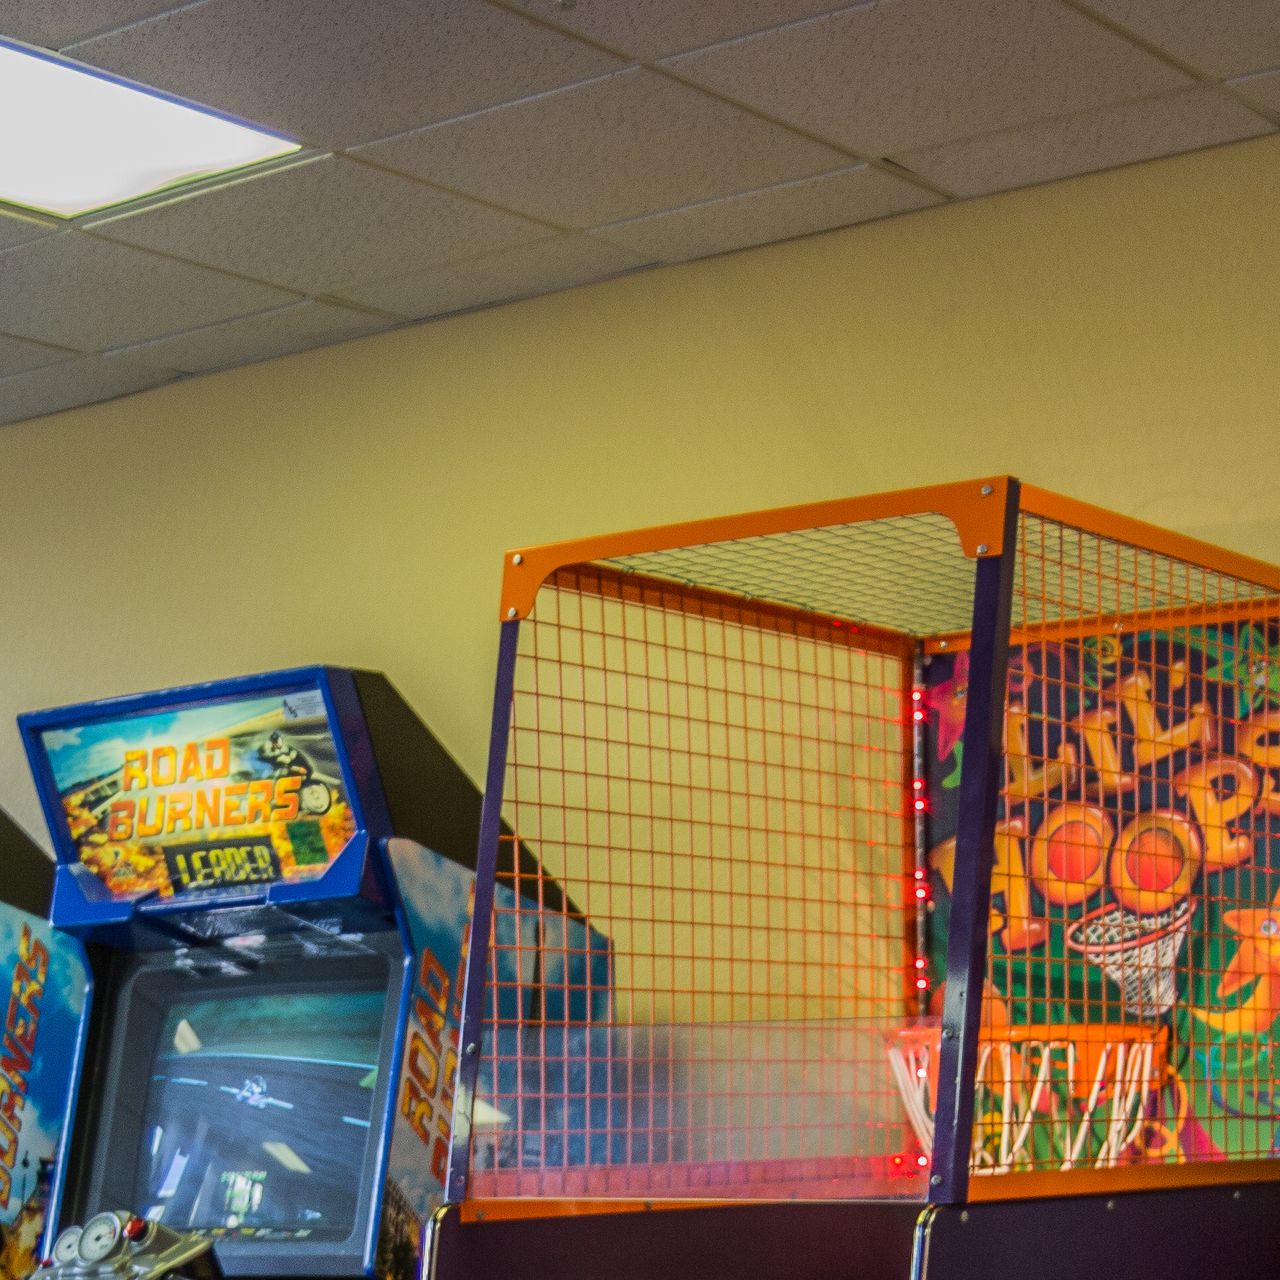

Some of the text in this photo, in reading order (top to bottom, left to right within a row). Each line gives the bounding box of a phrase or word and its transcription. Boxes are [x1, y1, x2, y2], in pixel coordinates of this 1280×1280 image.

[122, 736, 231, 791] ROAD
[107, 775, 302, 841] BURNERS
[400, 947, 450, 1146] ROAD
